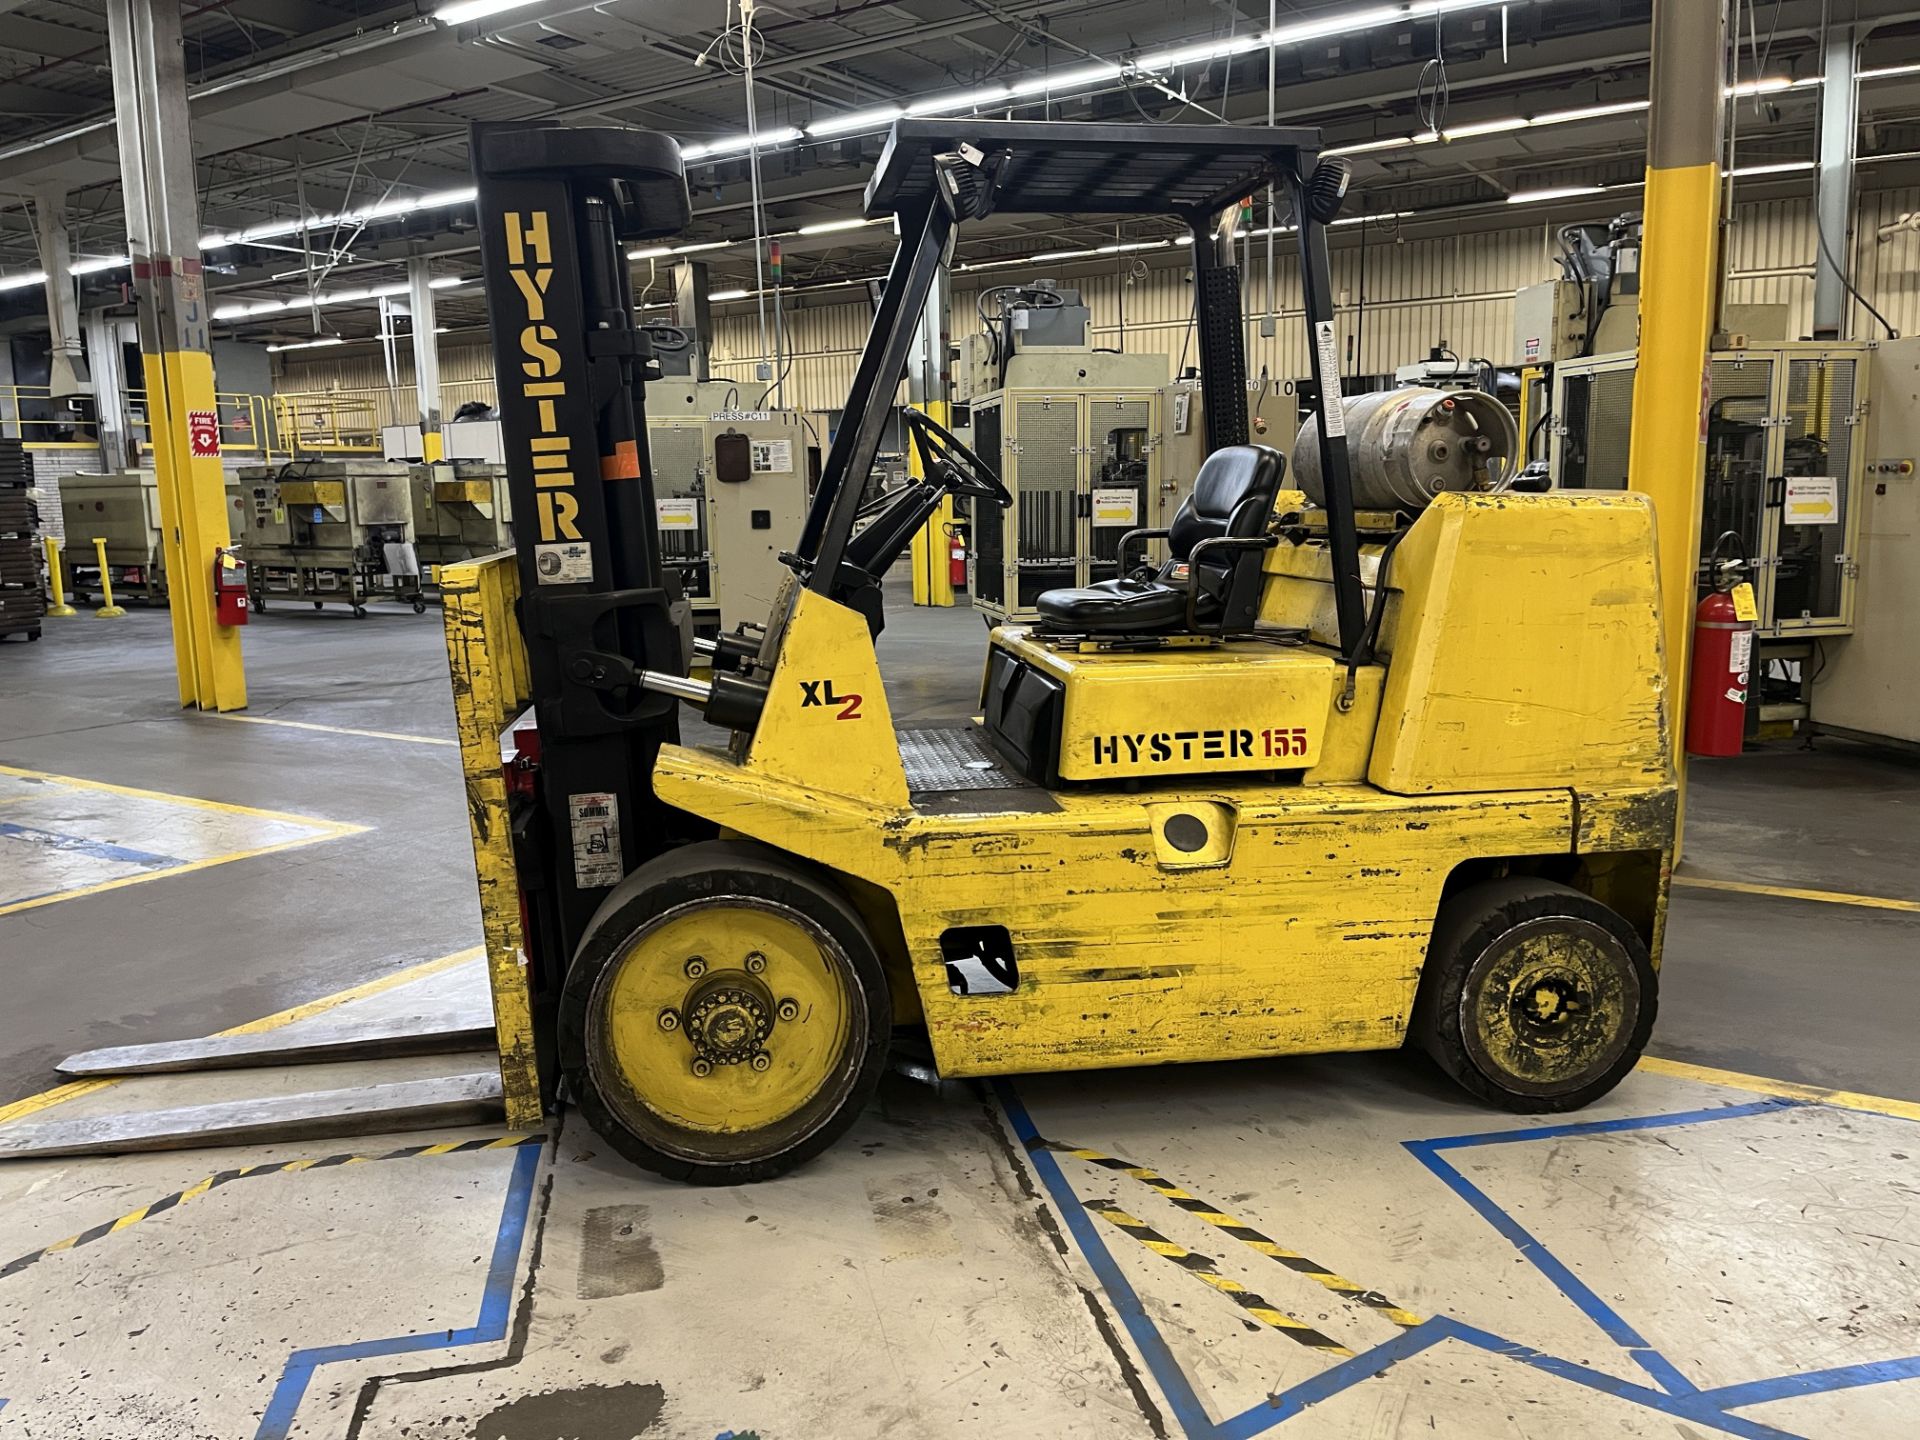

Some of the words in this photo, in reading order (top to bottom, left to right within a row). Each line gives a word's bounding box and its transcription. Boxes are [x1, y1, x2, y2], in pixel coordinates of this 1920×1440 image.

[186, 301, 198, 322] J
[184, 327, 205, 348] 11
[503, 210, 583, 541] HYSTER
[1275, 381, 1294, 395] 10
[194, 416, 212, 425] FIRE
[783, 412, 798, 426] 11
[1094, 729, 1255, 765] HYSTER
[1261, 727, 1308, 758] 155
